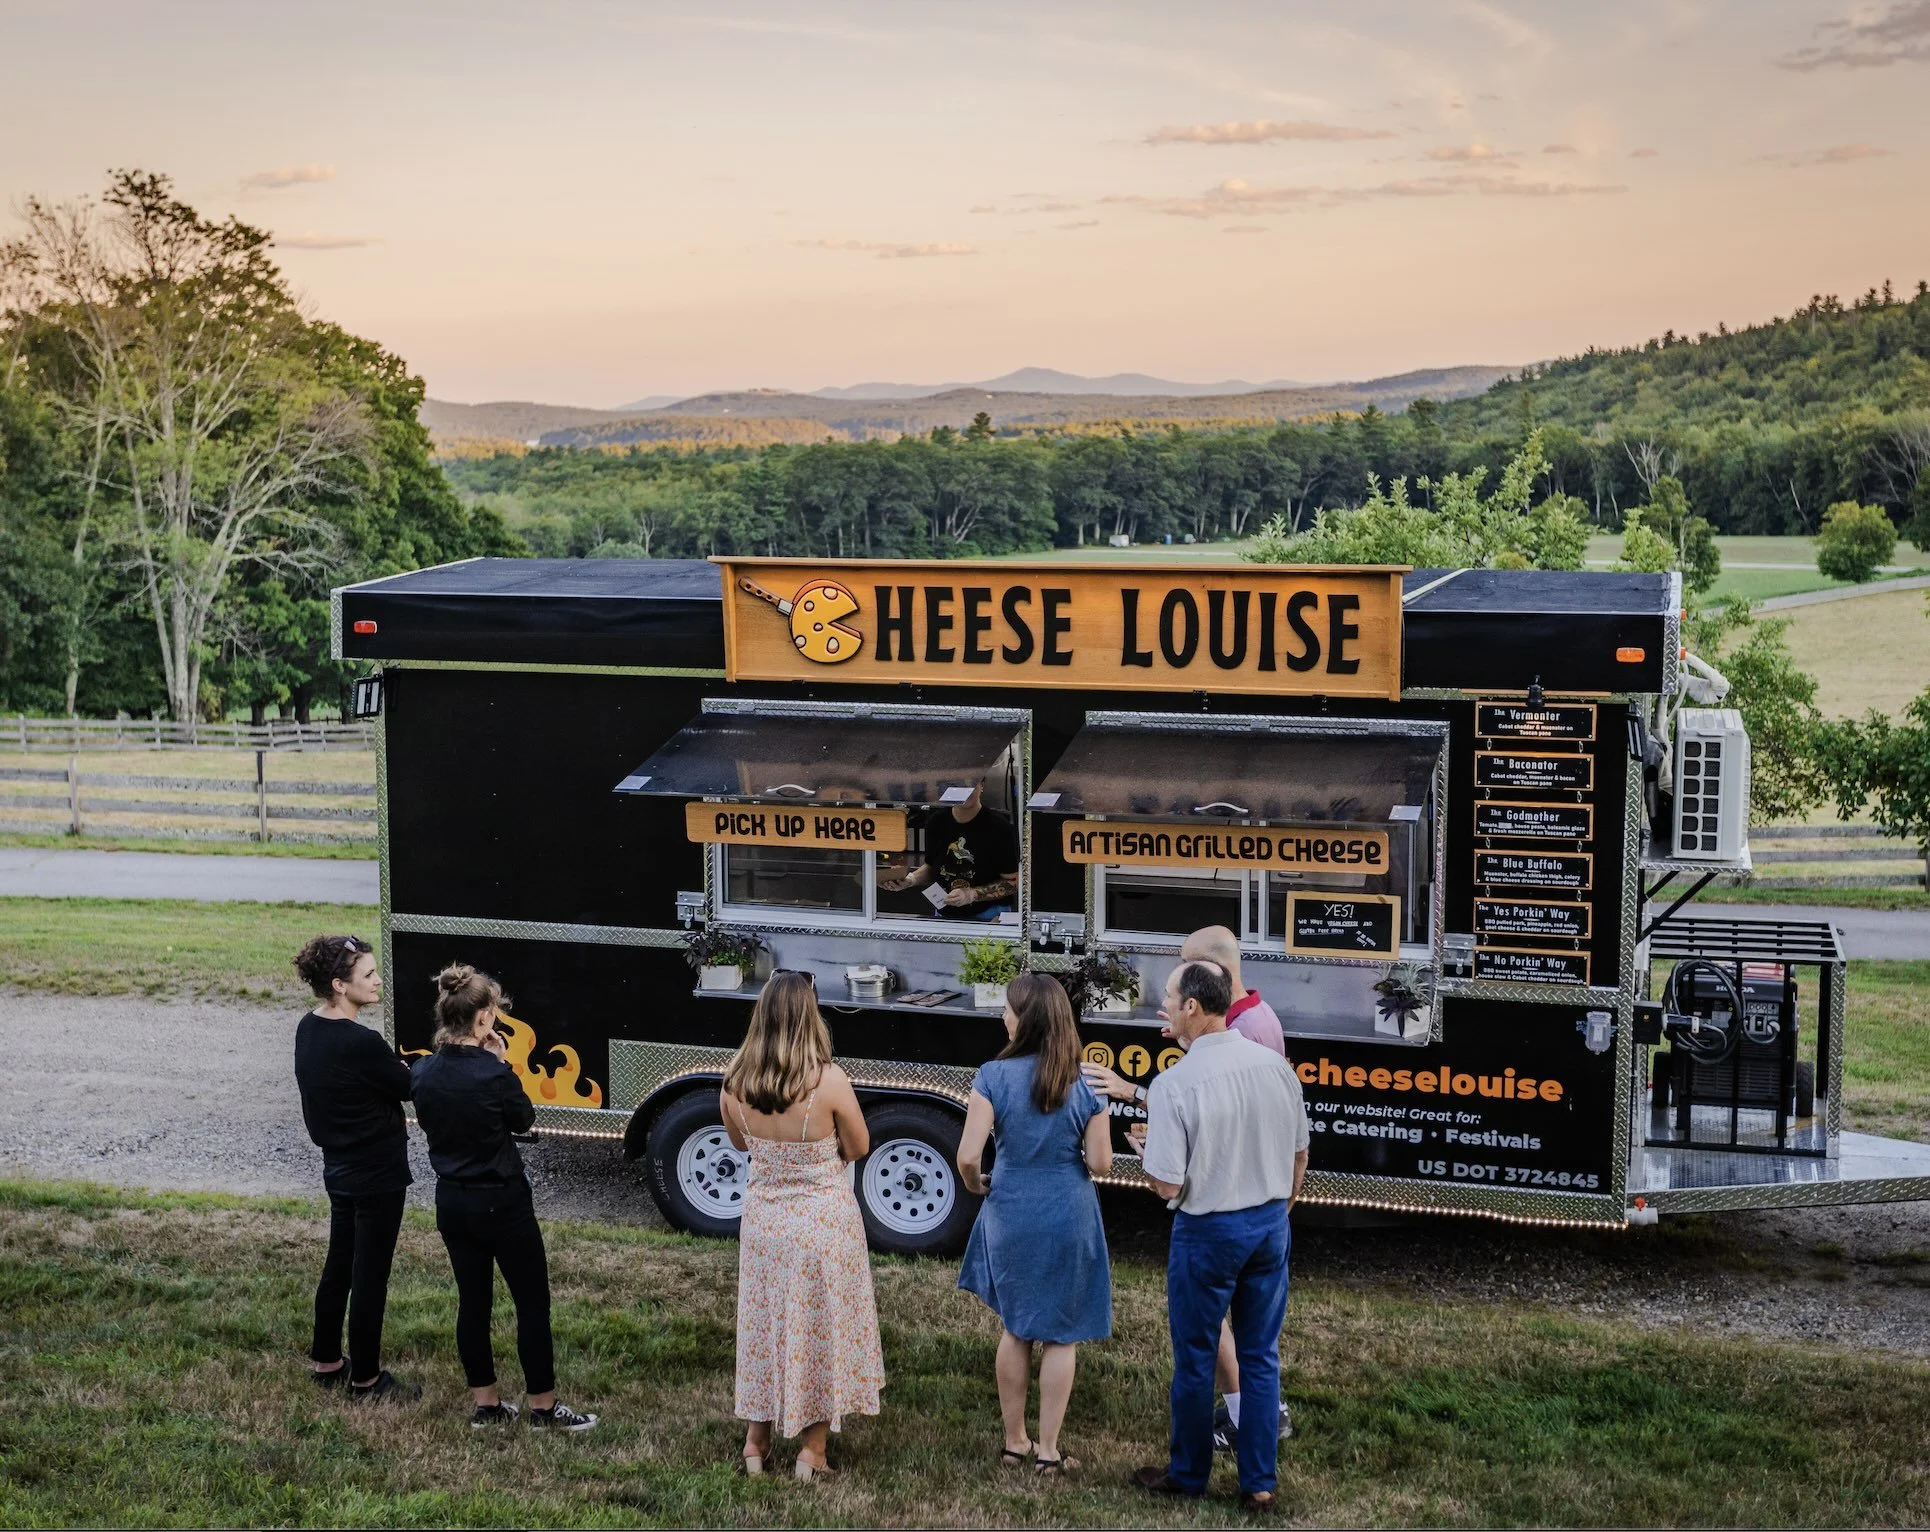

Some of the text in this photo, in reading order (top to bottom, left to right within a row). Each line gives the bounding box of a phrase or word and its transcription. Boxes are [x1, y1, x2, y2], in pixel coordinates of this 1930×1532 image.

[1121, 588, 1360, 674] LOUISE
[1510, 709, 1560, 720] Vermonter
[1509, 758, 1558, 770] Baconator
[1507, 810, 1560, 822] Godmother
[1503, 858, 1523, 868] Blue
[1528, 859, 1562, 870] Buffalo
[1324, 904, 1354, 918] YES!
[1494, 906, 1509, 916] Yes
[1550, 908, 1570, 921] Way
[1494, 955, 1506, 965] No
[1547, 958, 1566, 970] Way
[1315, 1102, 1341, 1114] our
[1344, 1104, 1406, 1119] website!
[1409, 1108, 1452, 1122] Great
[1455, 1111, 1481, 1125] for:
[1332, 1119, 1423, 1143] Catering
[1446, 1129, 1541, 1150] Festivals
[1418, 1160, 1599, 1189] US DOT 3724845
